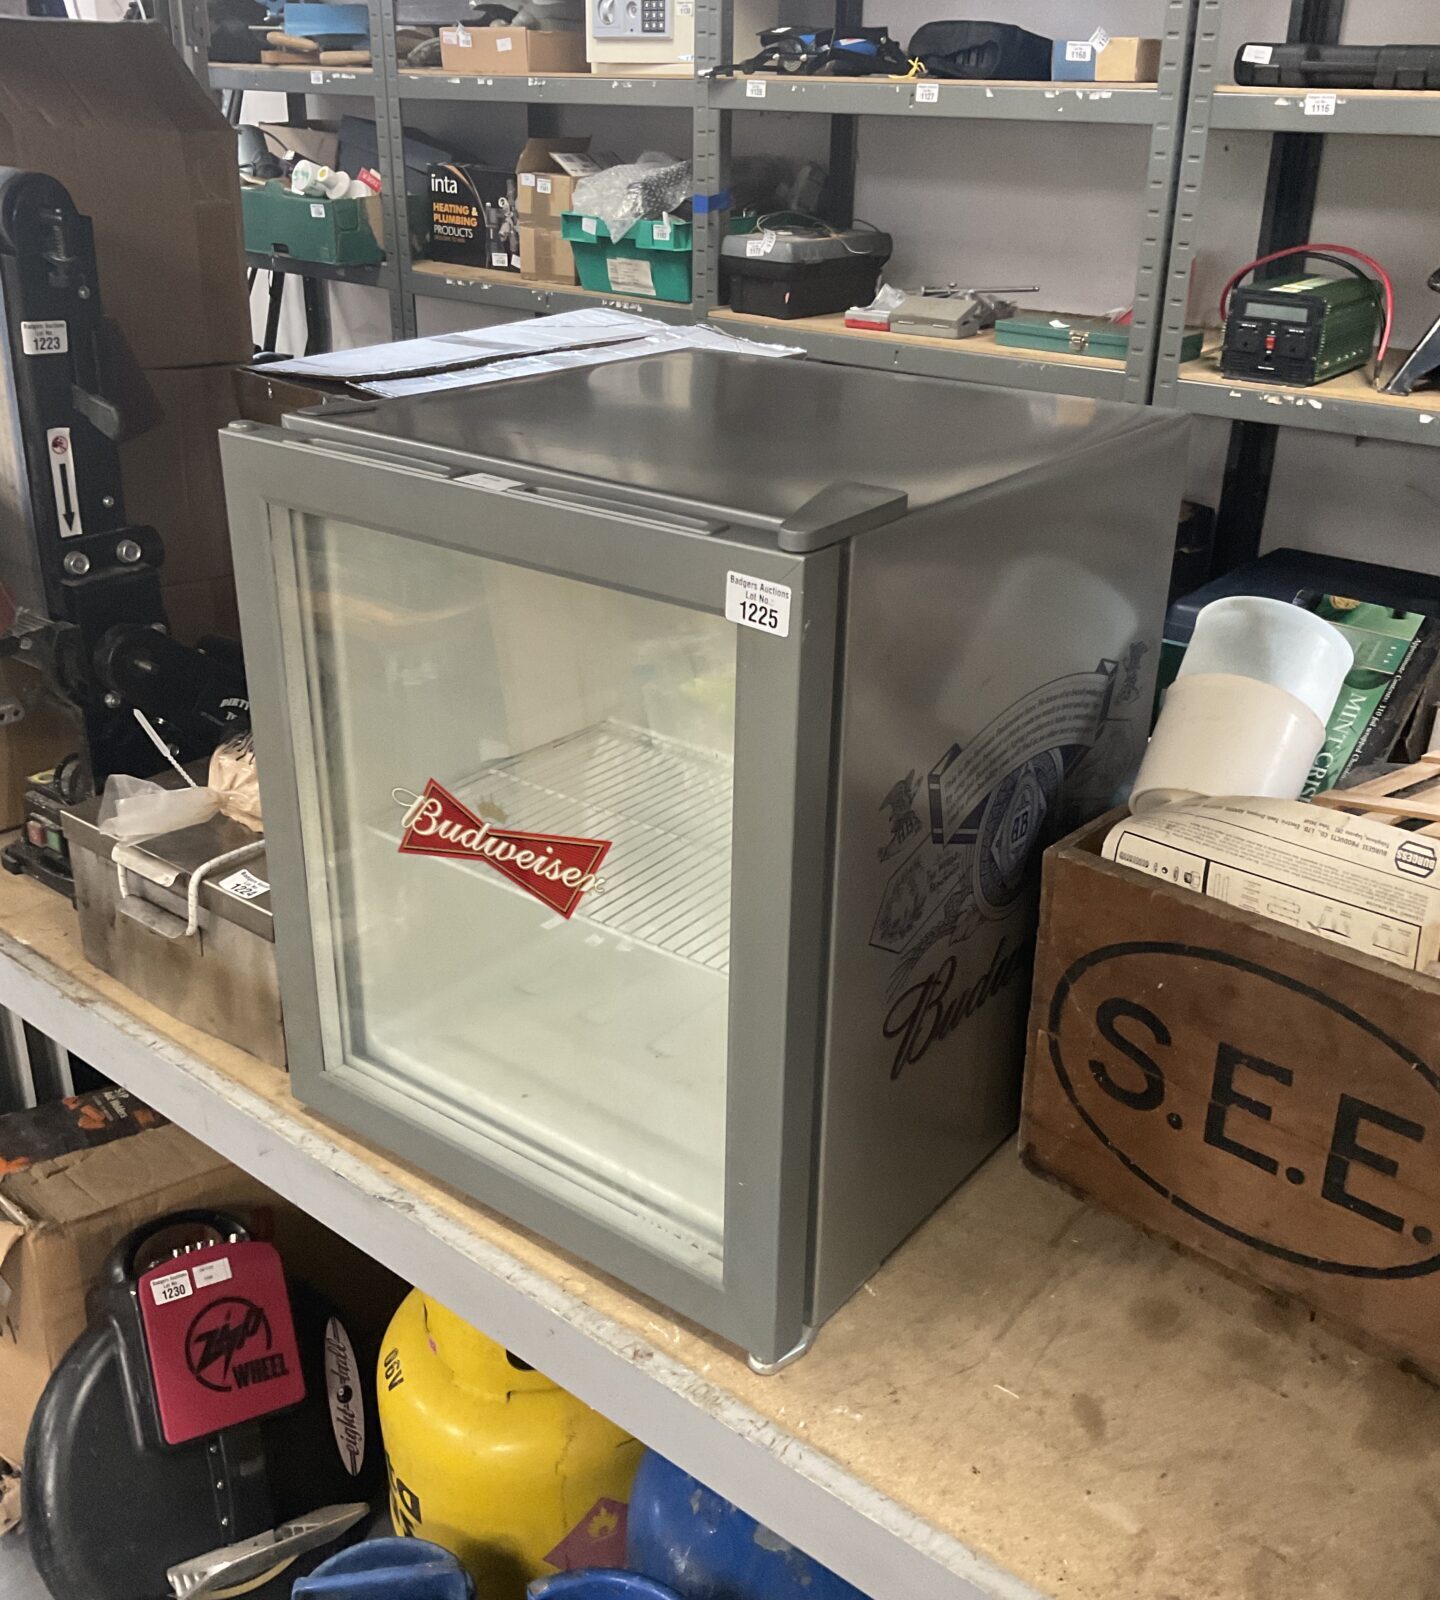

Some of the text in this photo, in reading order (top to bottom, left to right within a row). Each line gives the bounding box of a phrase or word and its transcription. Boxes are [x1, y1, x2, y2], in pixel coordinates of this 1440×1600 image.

[431, 173, 458, 194] inta
[433, 202, 479, 217] HEATING &
[433, 213, 478, 227] PLUMBING
[434, 224, 474, 239] PRODUCTS
[33, 336, 61, 351] 1223
[730, 574, 789, 599] Badgers Auctions
[746, 590, 756, 601] Lot
[740, 600, 778, 629] 1225
[392, 787, 607, 895] Budweiser
[1396, 850, 1436, 870] BURGESS
[230, 884, 258, 897] 1224
[162, 1284, 186, 1300] 1230
[232, 1353, 290, 1389] WHEEL
[336, 1402, 362, 1456] eight
